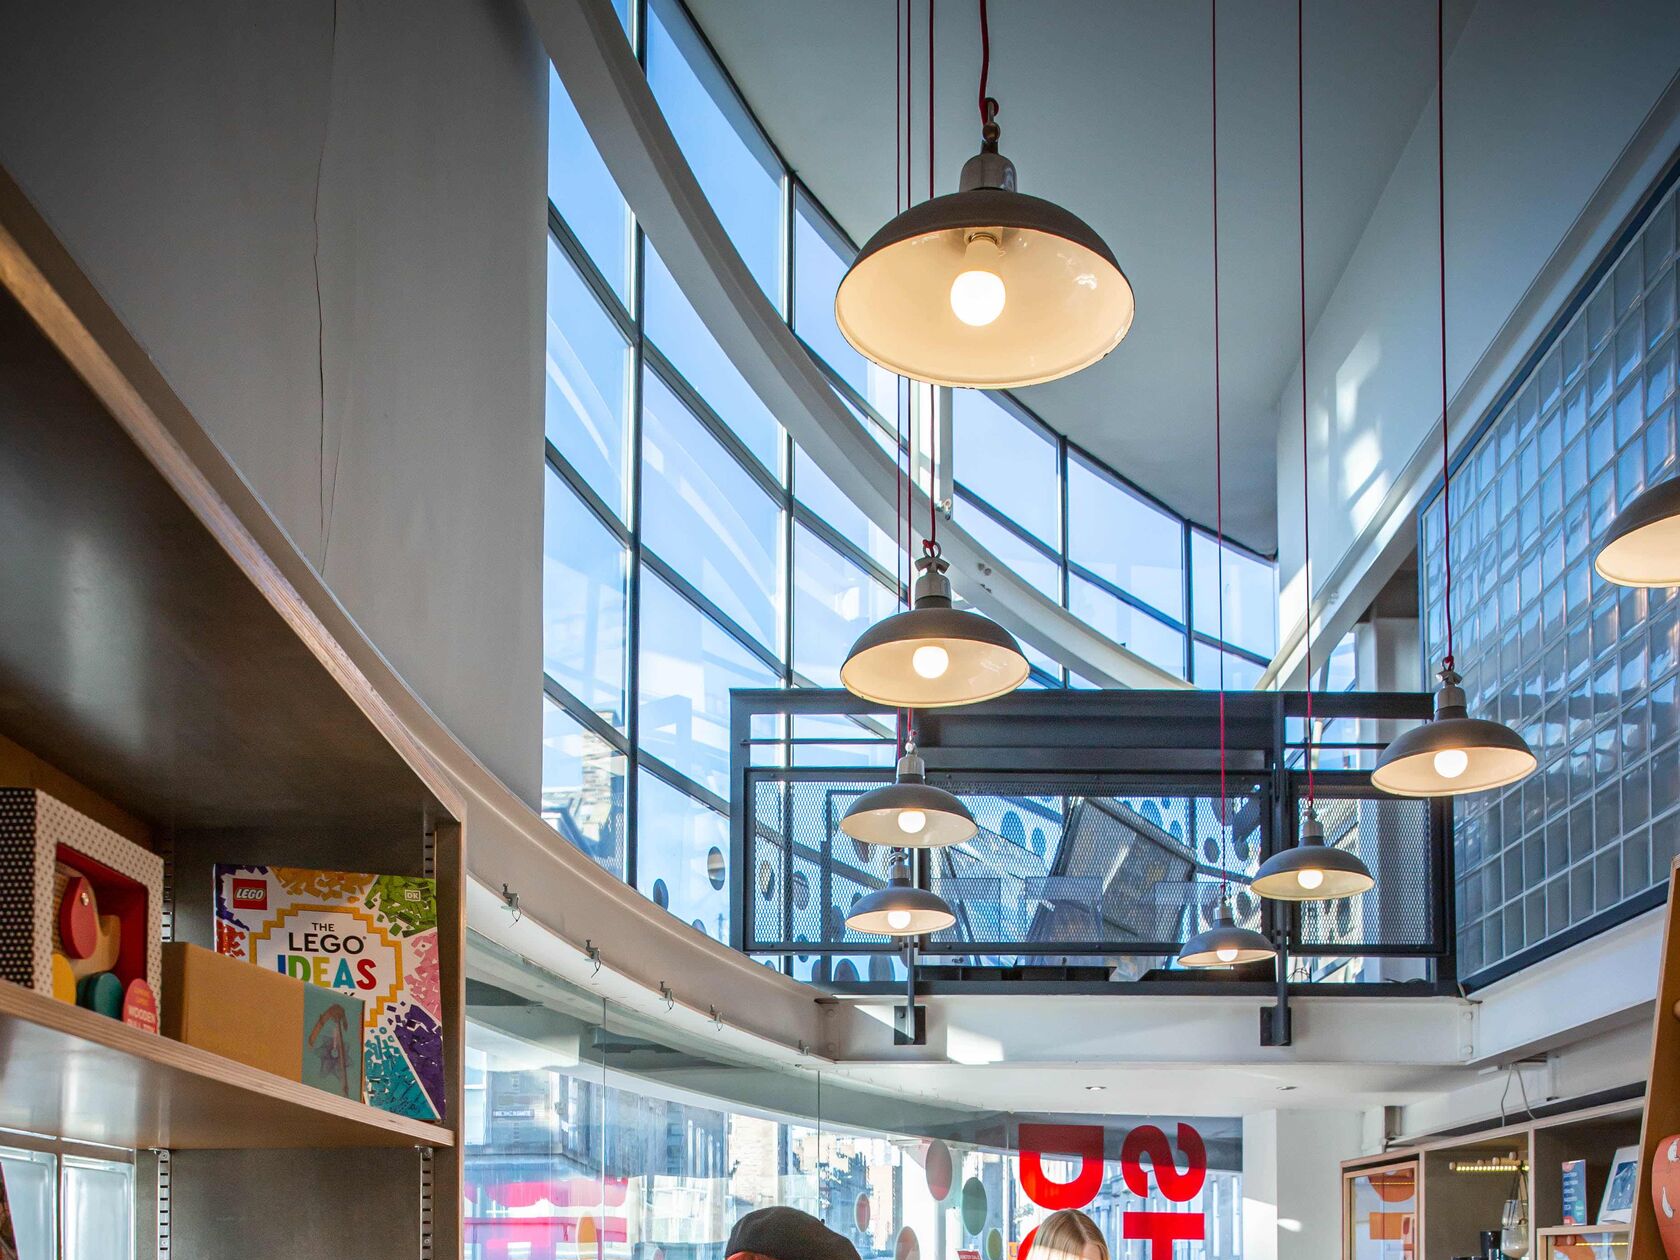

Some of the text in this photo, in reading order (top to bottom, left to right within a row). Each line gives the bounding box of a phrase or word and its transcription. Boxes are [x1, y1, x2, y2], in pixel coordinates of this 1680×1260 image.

[235, 887, 265, 900] LEGO
[406, 891, 419, 900] DK
[311, 922, 335, 932] THE
[288, 931, 364, 955] LEGO
[277, 954, 377, 991] IDEAS
